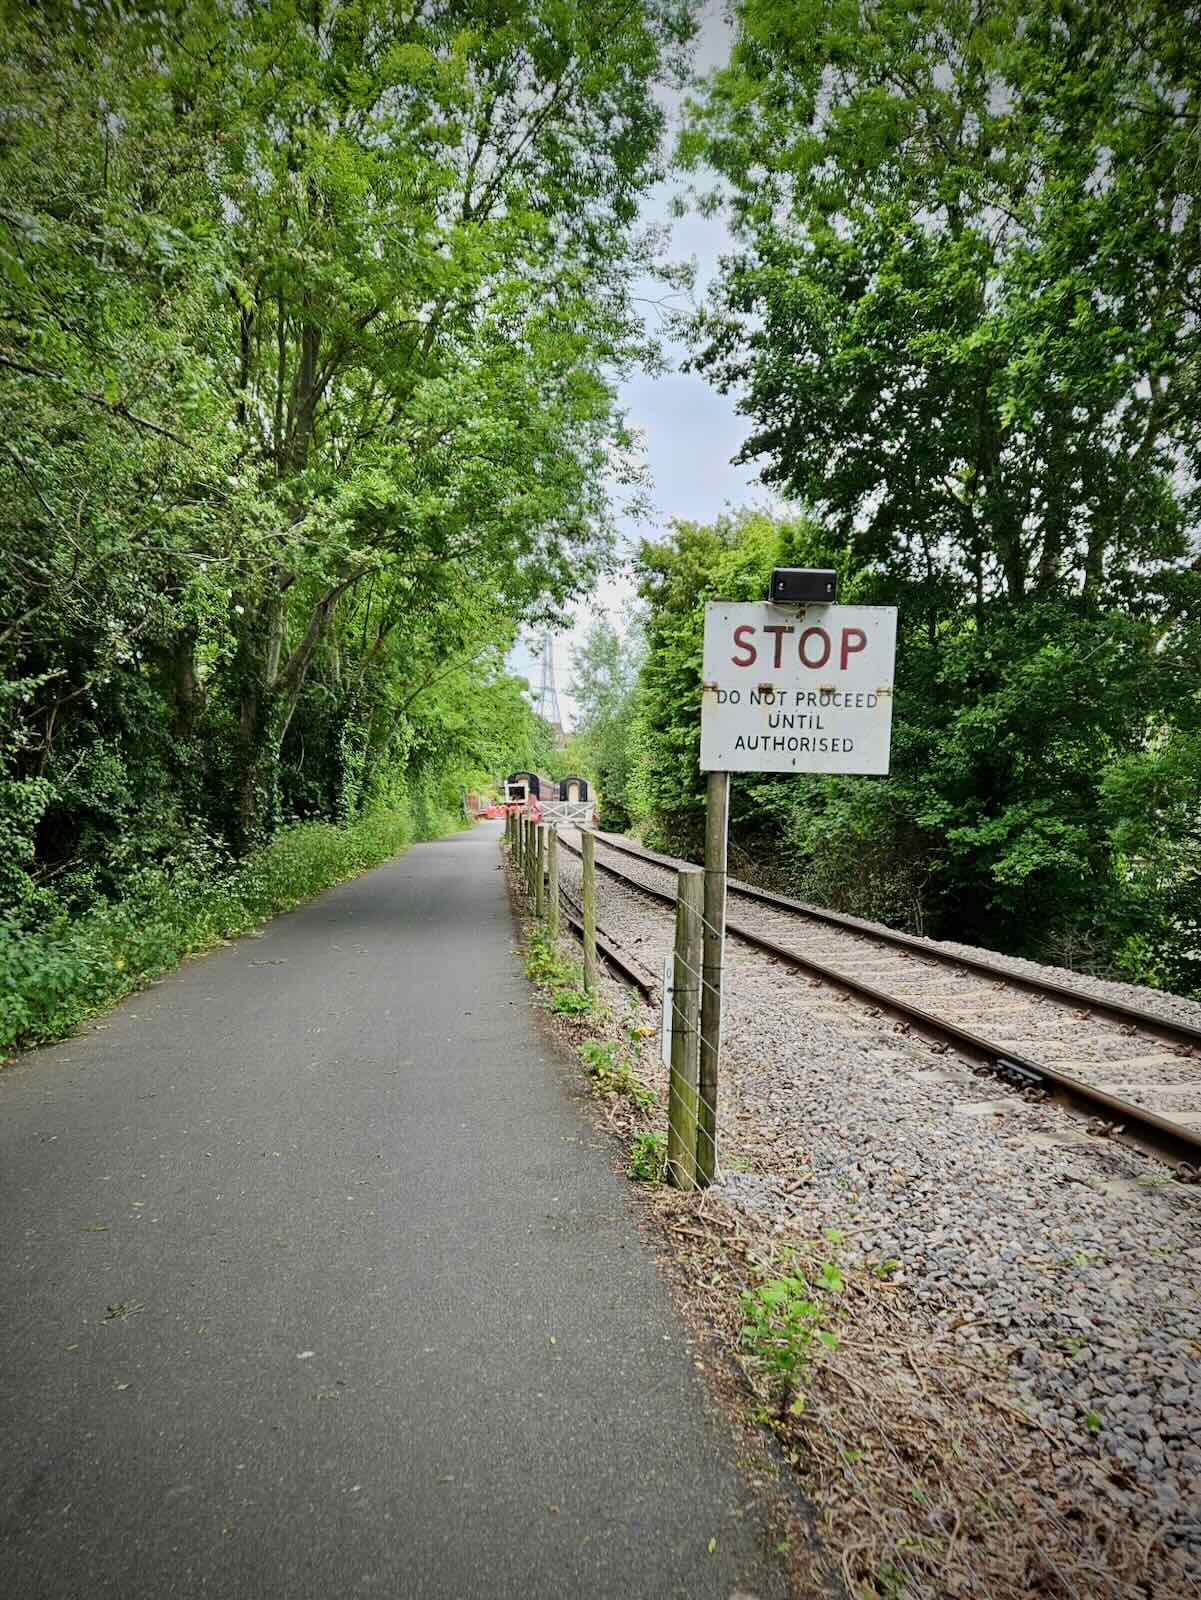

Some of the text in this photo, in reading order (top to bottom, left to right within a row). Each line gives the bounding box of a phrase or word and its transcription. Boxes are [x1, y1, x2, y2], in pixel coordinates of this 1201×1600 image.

[731, 625, 868, 670] STOP
[717, 690, 878, 709] DO NOT PROCEED
[768, 713, 825, 730] UNTIL
[735, 736, 854, 753] AUTHORISED
